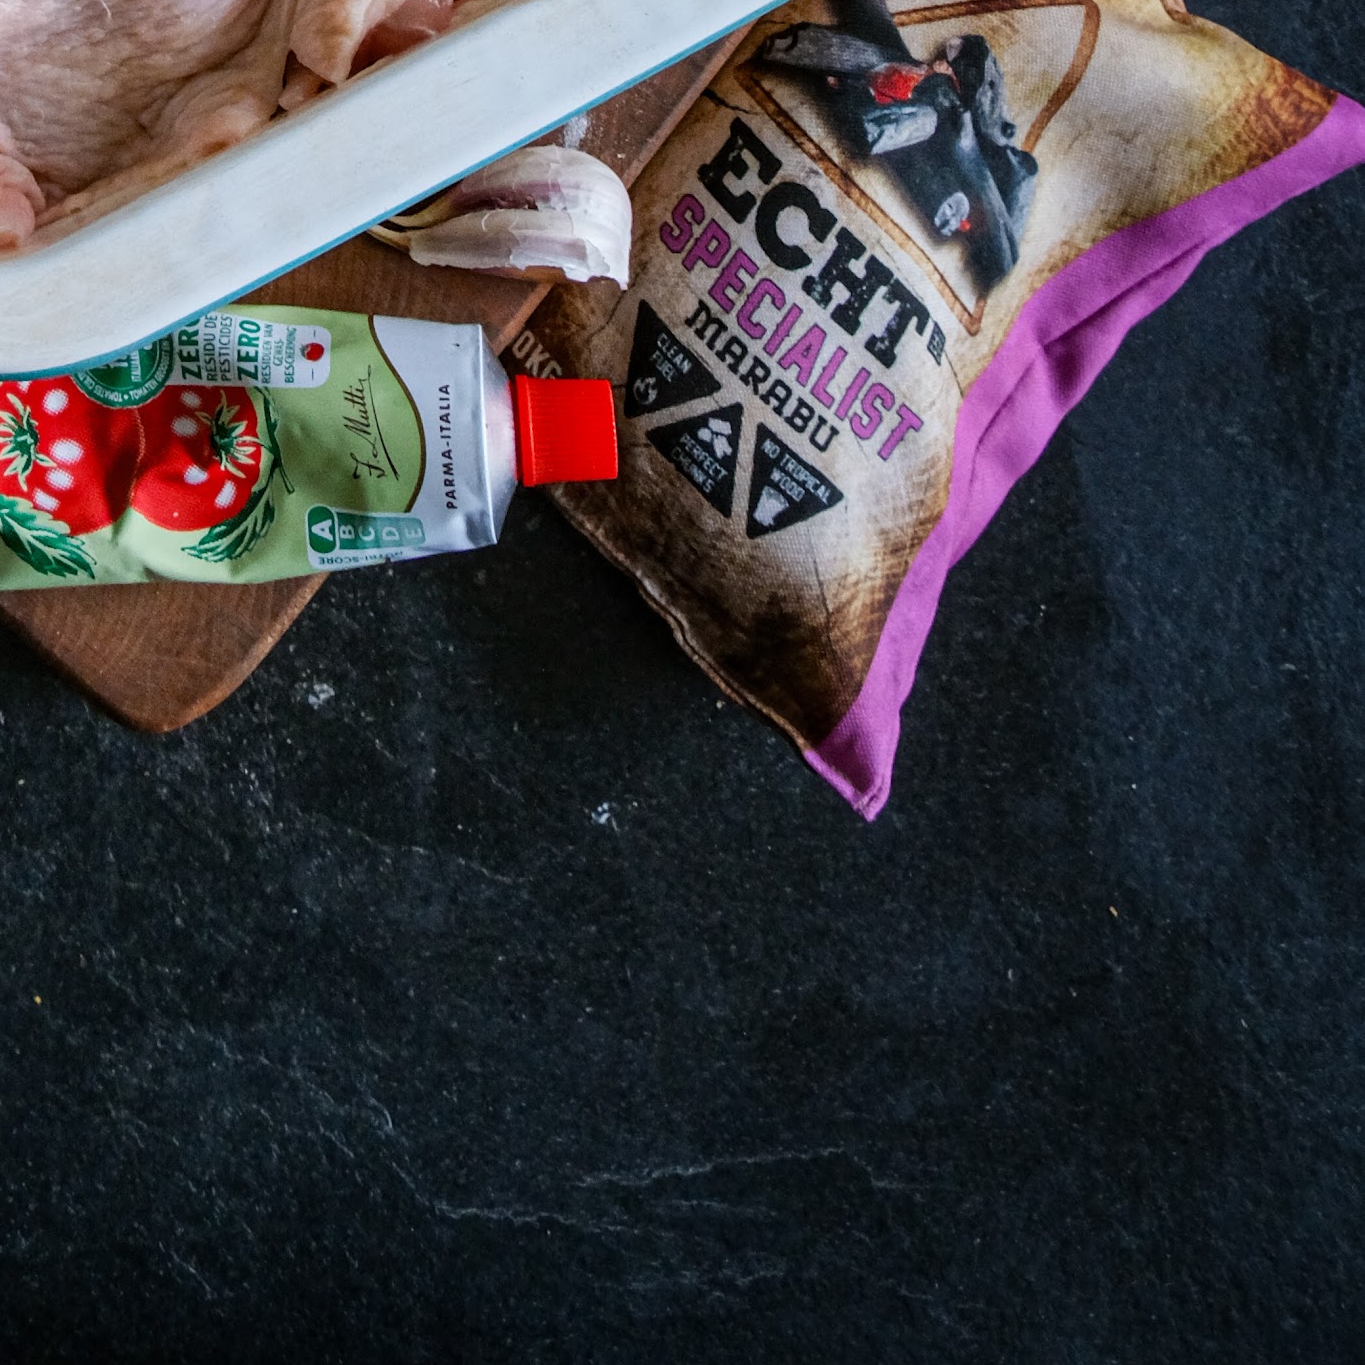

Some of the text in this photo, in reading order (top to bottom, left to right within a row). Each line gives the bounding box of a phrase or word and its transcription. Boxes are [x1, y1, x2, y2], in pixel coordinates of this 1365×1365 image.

[697, 116, 931, 369] ECHT
[203, 314, 218, 381] RÉSIDU DE
[219, 314, 233, 381] PESTICIDES
[237, 319, 261, 381] ZERO
[657, 333, 692, 374] CLEAN
[659, 194, 924, 461] SPECIALIST
[650, 350, 674, 383] FUEL
[685, 299, 840, 453] MARABU
[438, 384, 458, 510] PARMA-ITALIA
[680, 433, 728, 481] PERFECT
[761, 438, 832, 505] NO TROPICAL
[770, 468, 806, 502] WOOD
[311, 519, 422, 541] A B C D E
